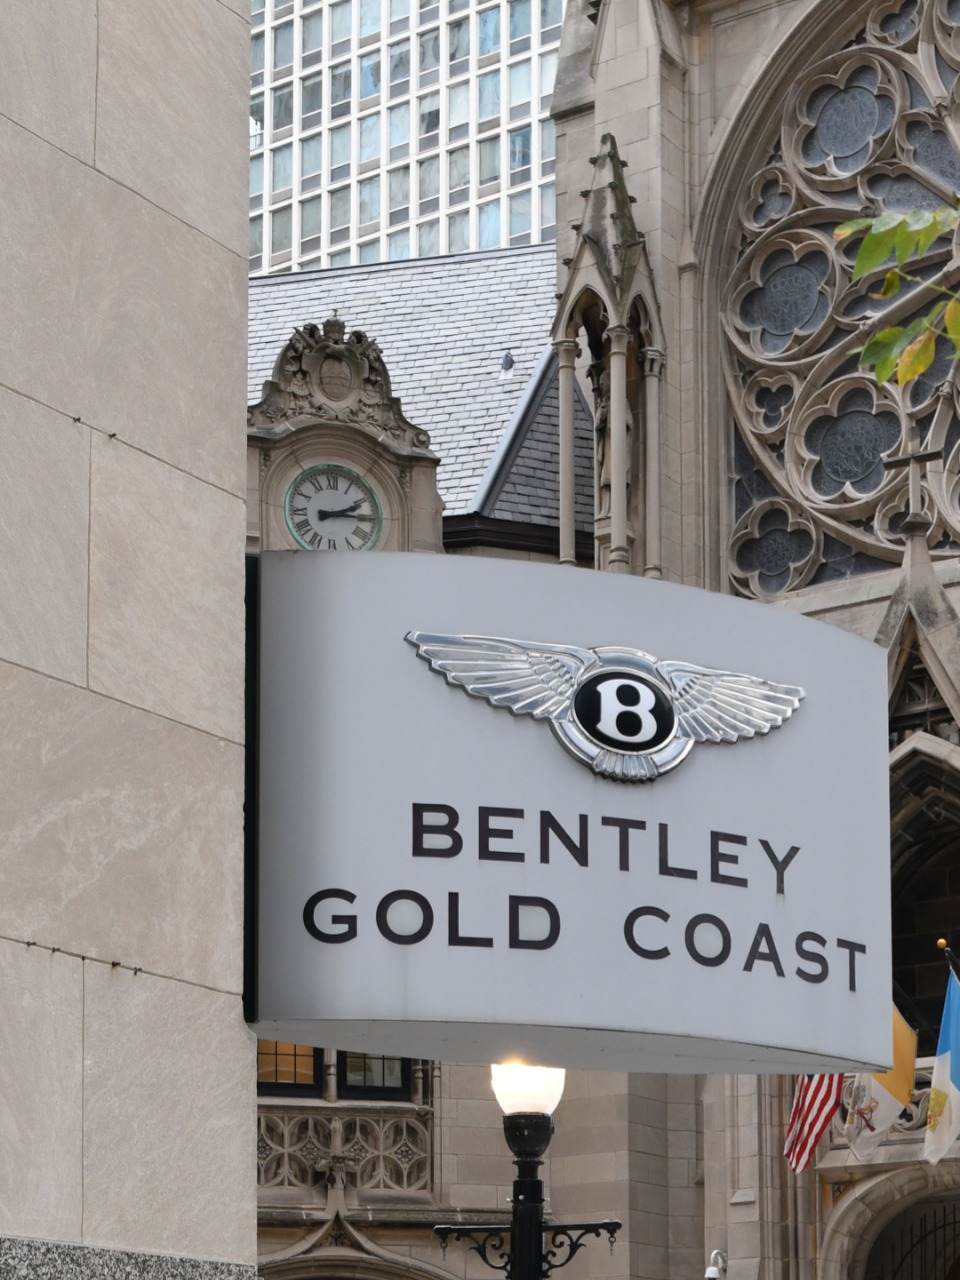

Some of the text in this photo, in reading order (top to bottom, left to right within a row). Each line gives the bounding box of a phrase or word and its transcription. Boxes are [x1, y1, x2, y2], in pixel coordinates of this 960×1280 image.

[596, 678, 658, 743] B
[411, 802, 801, 895] BENTLEY
[302, 887, 867, 992] GOLD COAST
